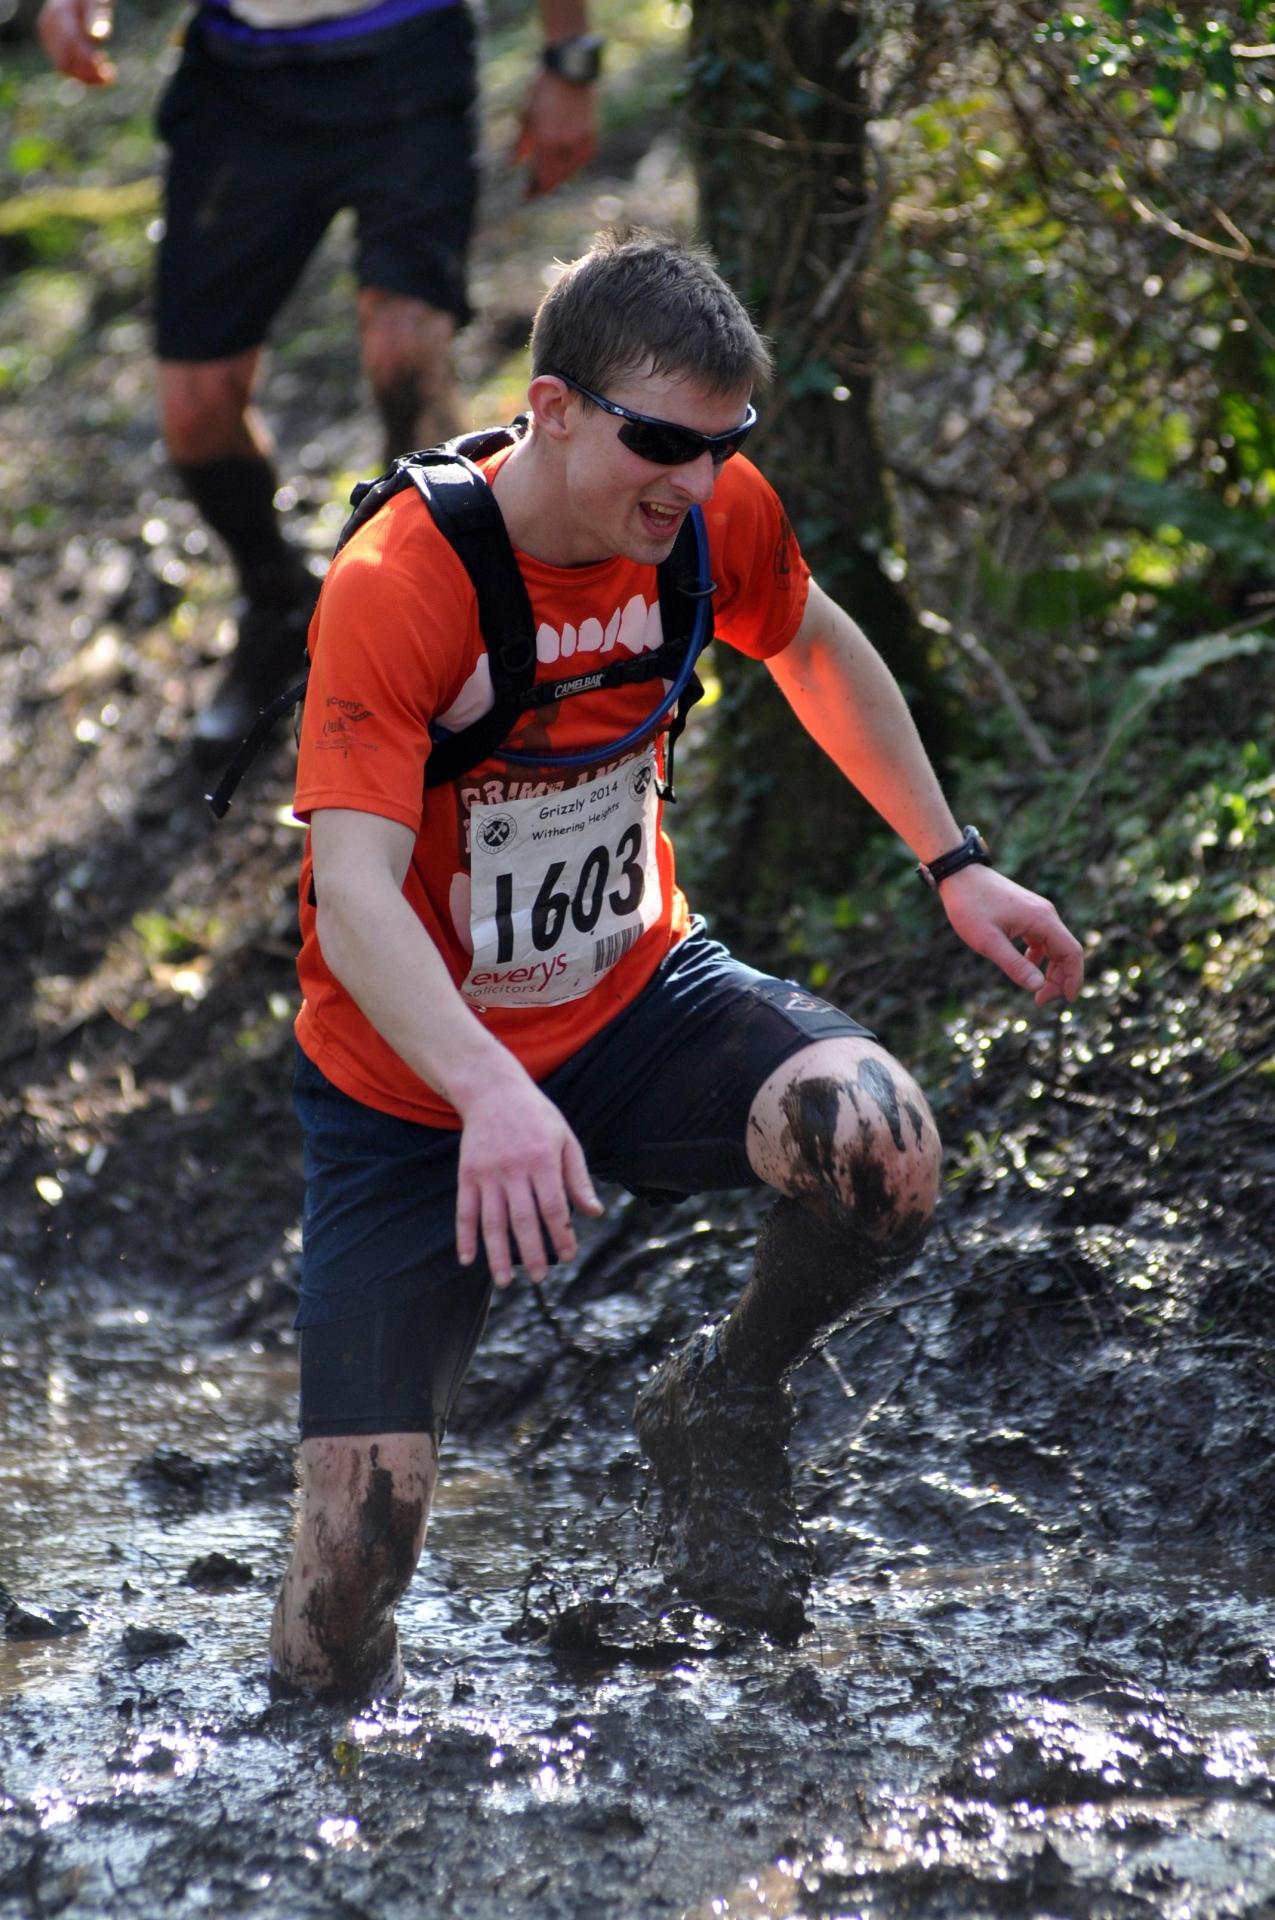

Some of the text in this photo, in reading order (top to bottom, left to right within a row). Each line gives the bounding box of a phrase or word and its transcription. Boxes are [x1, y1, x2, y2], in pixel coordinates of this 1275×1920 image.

[555, 673, 605, 698] CAMELBAK
[539, 781, 618, 819] Grizzly 2014
[532, 821, 585, 841] Withering
[588, 802, 620, 825] Heights
[496, 823, 645, 964] 1603
[467, 984, 537, 998] solicitors
[471, 953, 567, 992] everys
